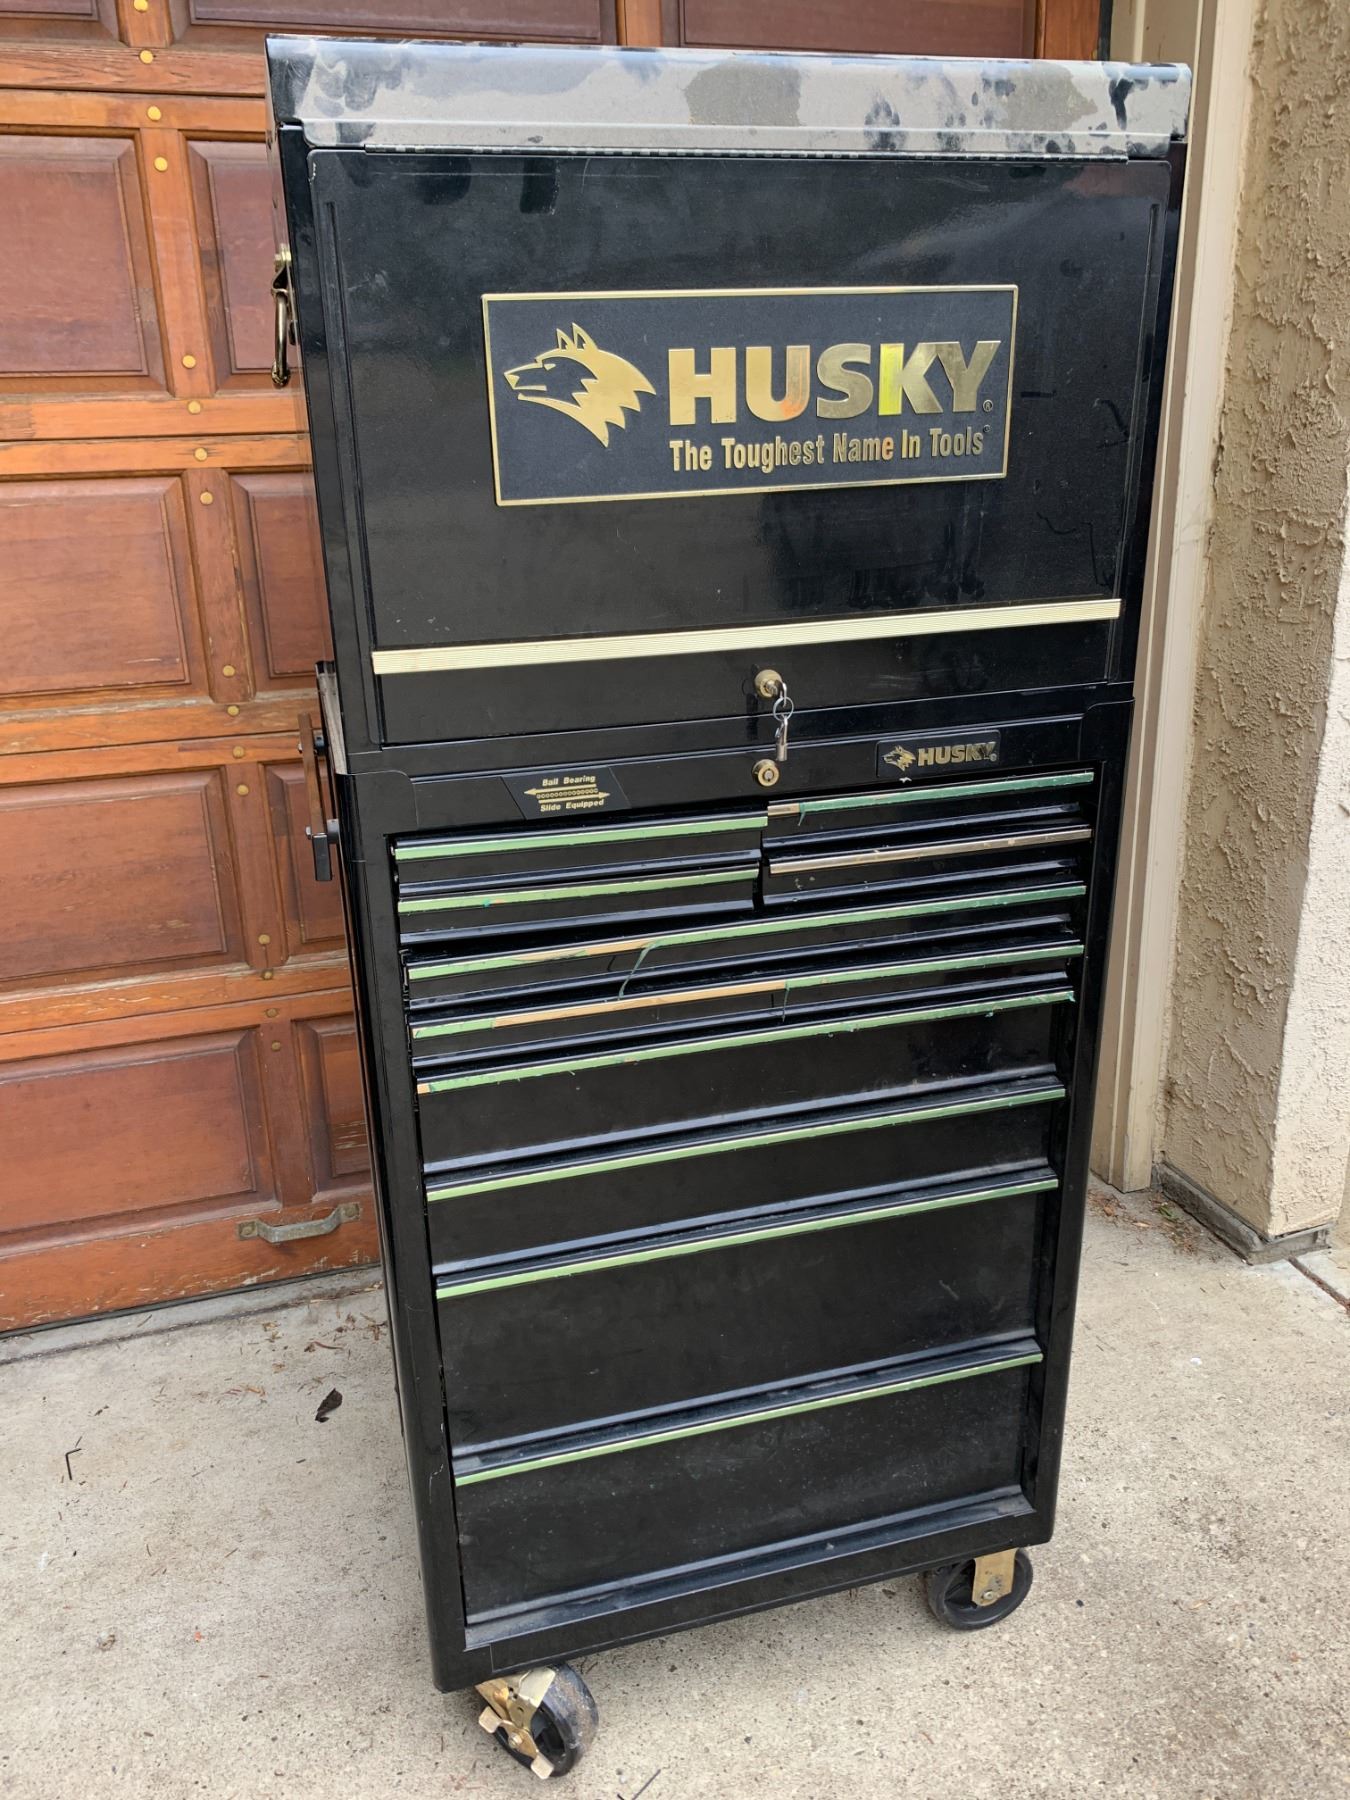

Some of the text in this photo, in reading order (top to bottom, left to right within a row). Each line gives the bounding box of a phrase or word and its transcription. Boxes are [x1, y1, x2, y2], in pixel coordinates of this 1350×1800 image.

[667, 339, 1002, 426] HUSKY
[669, 426, 984, 474] The Toughest Name In Tools
[917, 741, 997, 767] HUSKY
[542, 775, 597, 787] Ball Bearing
[540, 799, 605, 812] Slide Equipped
